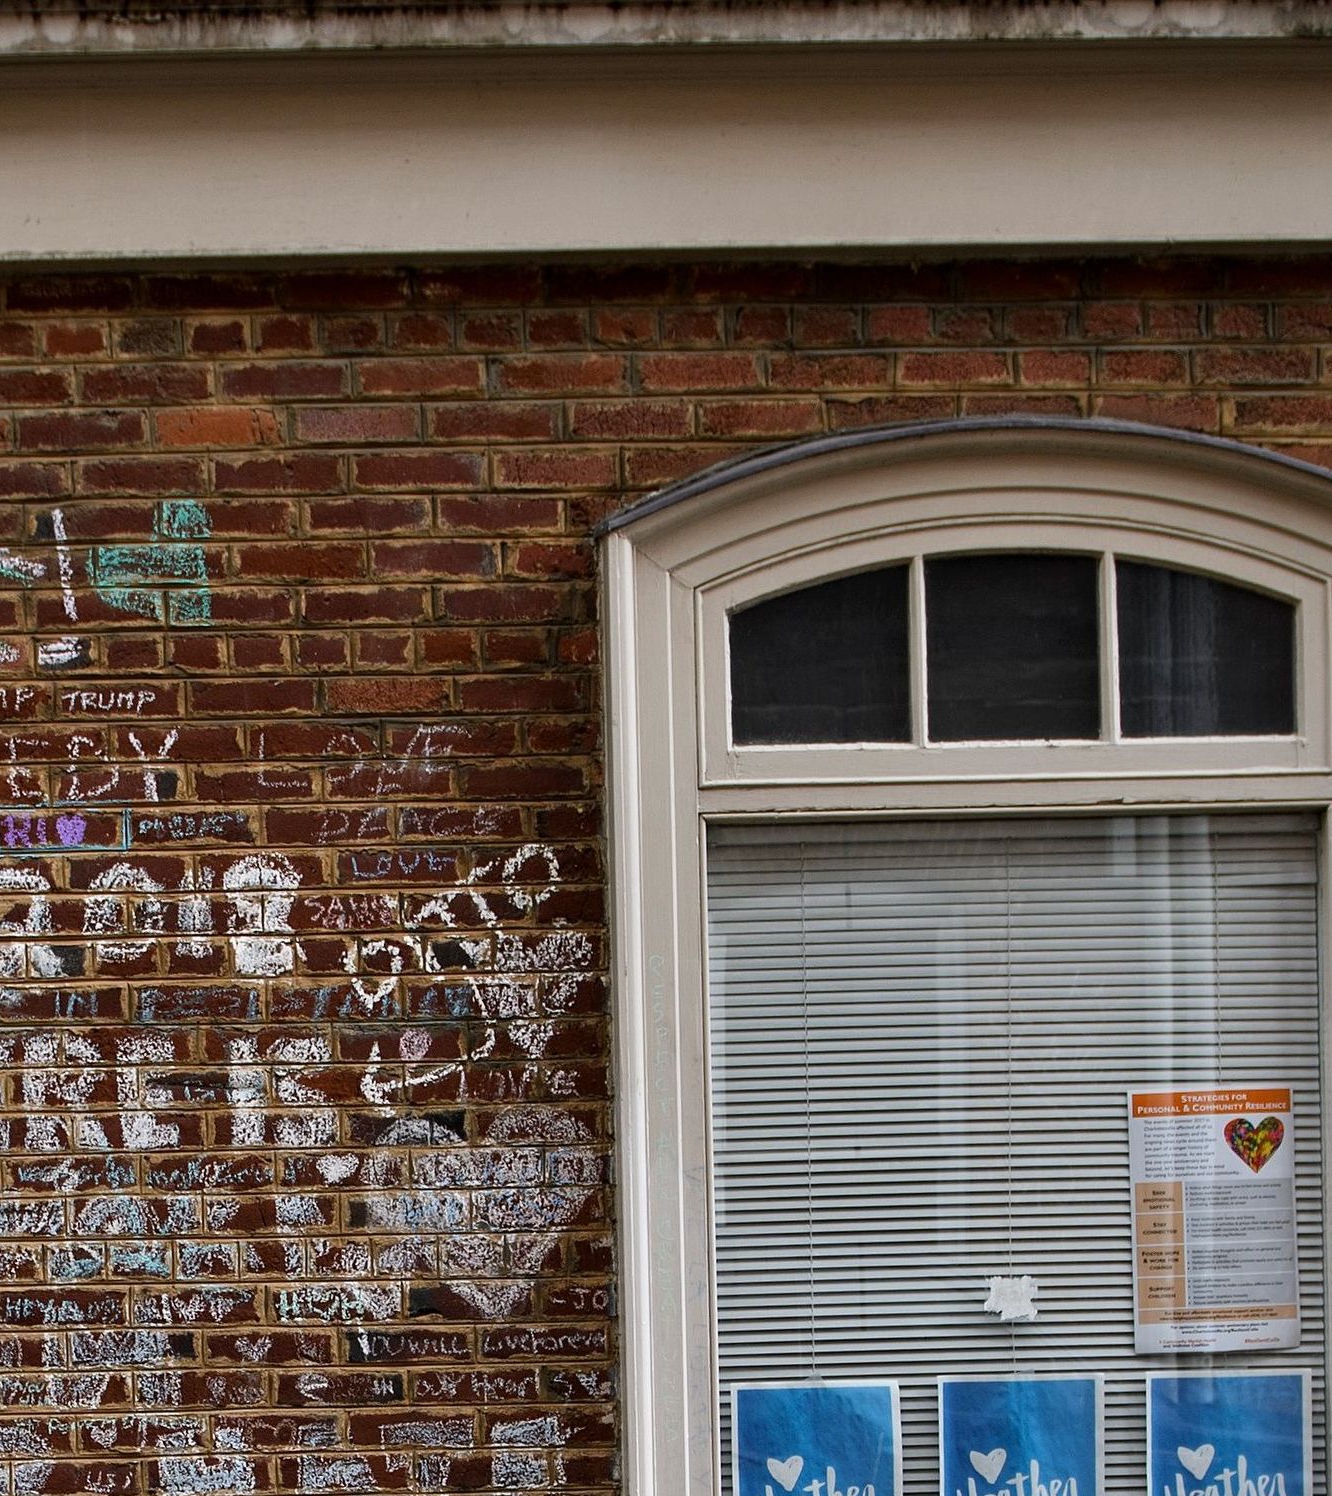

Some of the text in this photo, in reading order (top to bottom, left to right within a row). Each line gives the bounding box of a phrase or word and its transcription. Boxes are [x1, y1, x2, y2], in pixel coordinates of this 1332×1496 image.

[1181, 1095, 1229, 1104] STRATEGIES
[1138, 1105, 1180, 1114] PERSONAL
[1192, 1103, 1243, 1112] COMMUNITY
[1245, 1102, 1286, 1110] RESILIENCE
